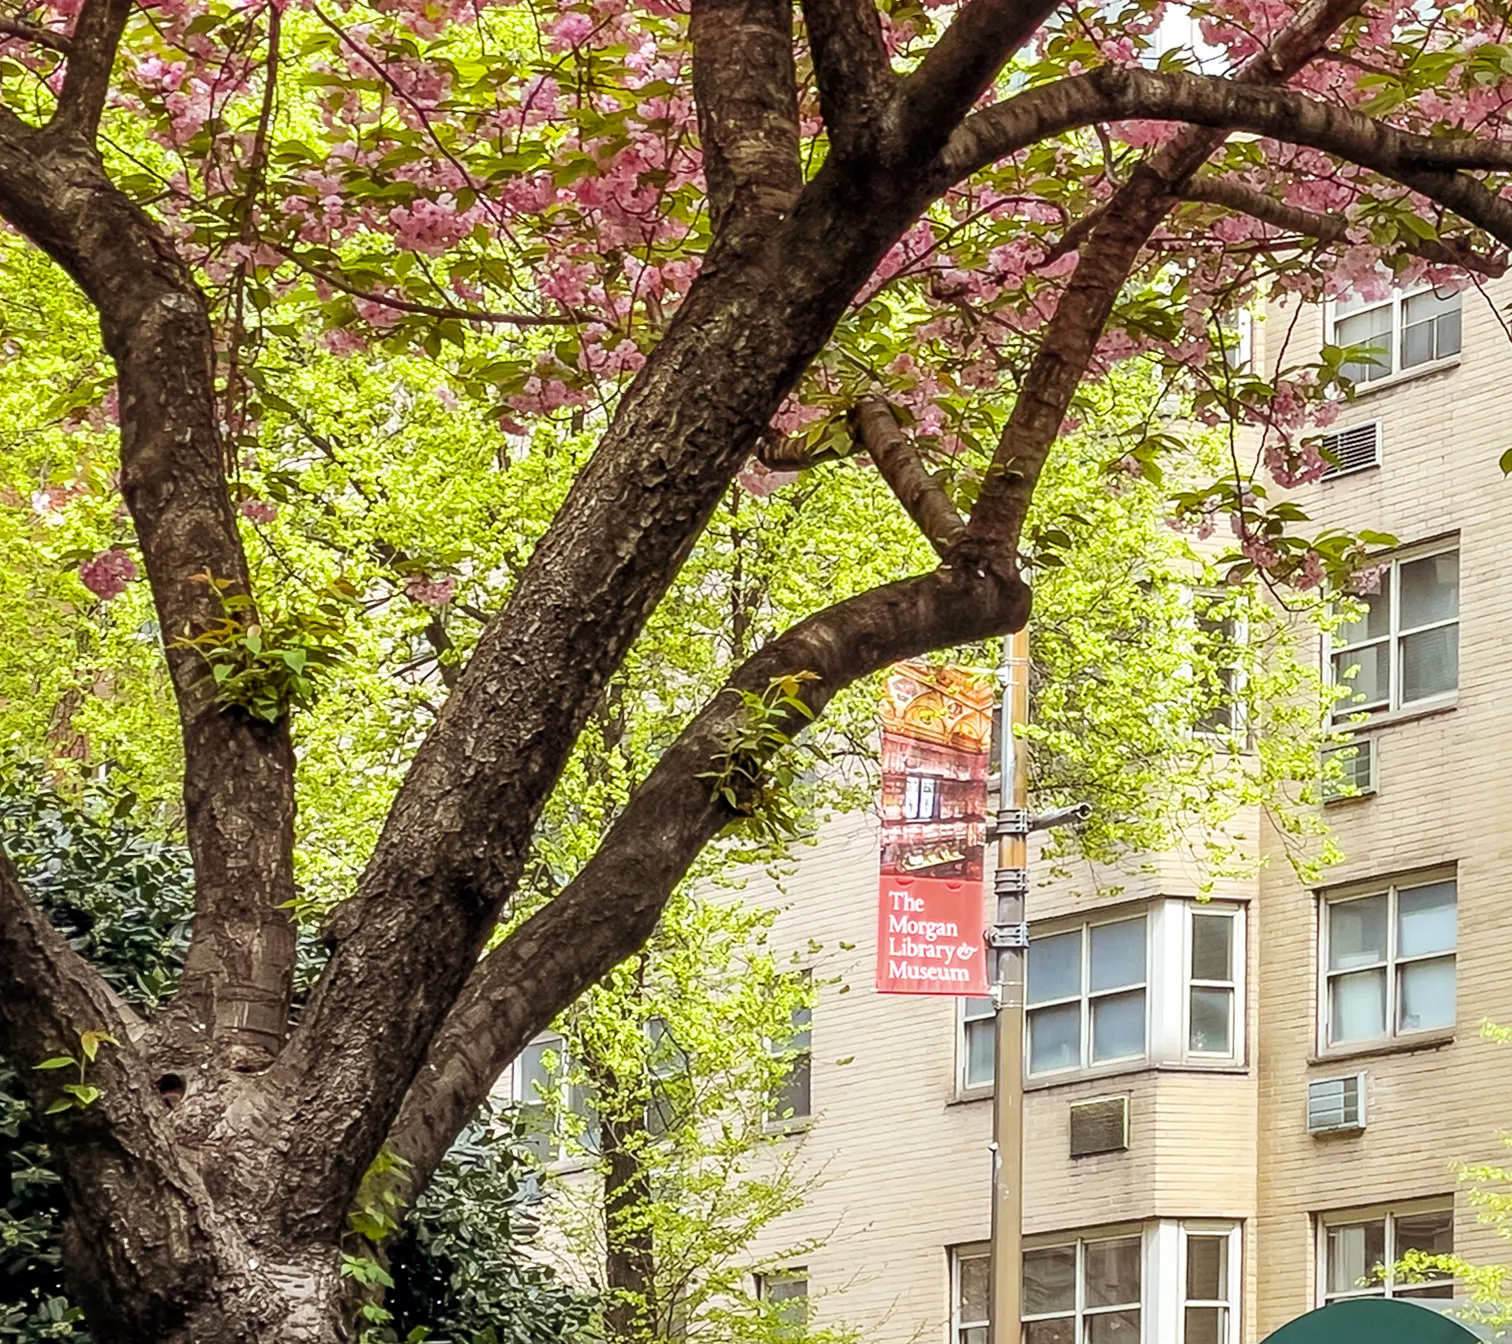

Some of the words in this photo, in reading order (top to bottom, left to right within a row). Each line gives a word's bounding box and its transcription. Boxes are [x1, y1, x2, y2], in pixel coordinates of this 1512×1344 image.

[888, 890, 925, 913] The
[888, 914, 959, 942] Morgan
[888, 937, 956, 965] Library
[888, 960, 971, 982] Museum
